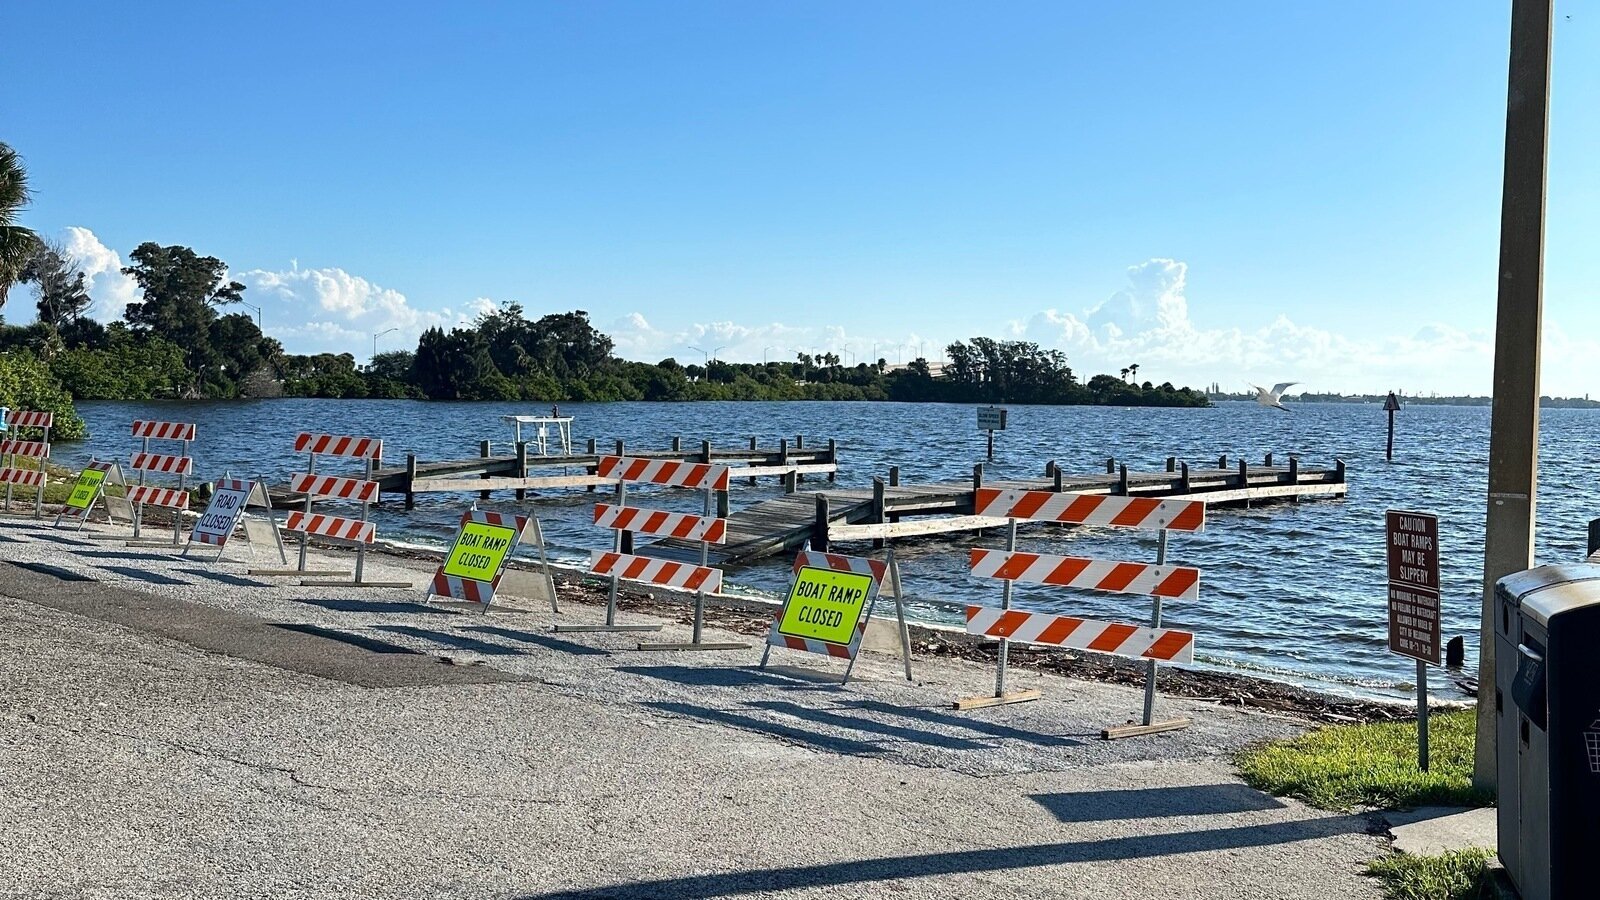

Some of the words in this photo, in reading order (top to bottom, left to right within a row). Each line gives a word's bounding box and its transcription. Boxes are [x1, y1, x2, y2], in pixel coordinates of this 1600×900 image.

[214, 494, 238, 510] ROAD
[201, 513, 231, 530] CLOSED
[1400, 516, 1426, 532] CAUTION
[460, 532, 483, 548] BOAT
[482, 536, 507, 552] RAMP
[1393, 532, 1410, 546] BOAT
[1410, 534, 1432, 550] RAMPS
[458, 552, 490, 570] CLOSED
[1402, 550, 1415, 564] MAY
[1417, 552, 1426, 566] BE
[1400, 566, 1428, 584] SLIPPERY
[796, 580, 828, 600] BOAT
[828, 586, 862, 605] RAMP
[798, 606, 843, 628] CLOSED
